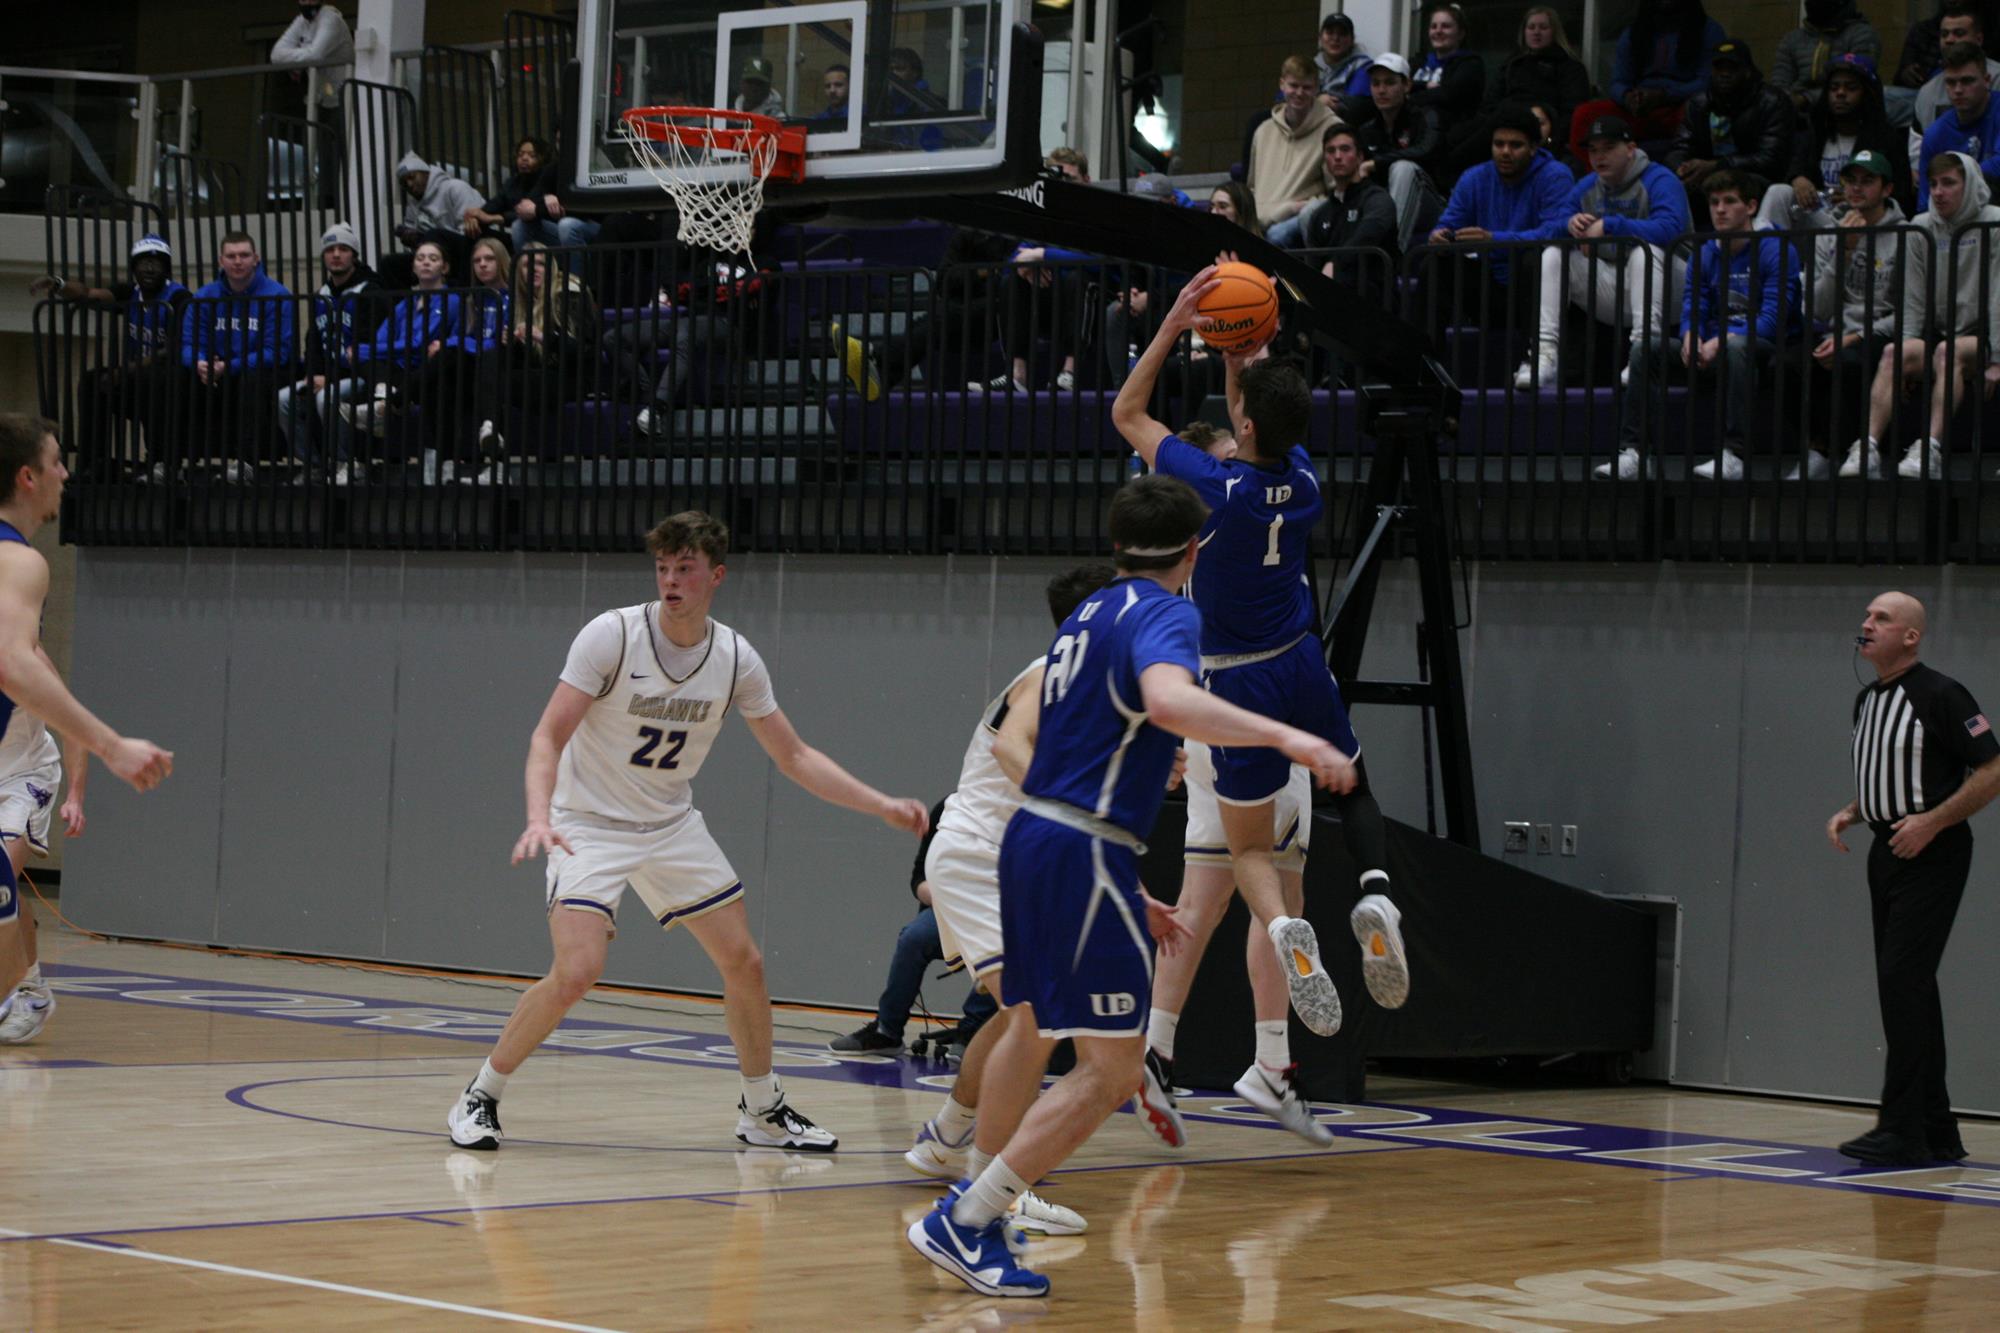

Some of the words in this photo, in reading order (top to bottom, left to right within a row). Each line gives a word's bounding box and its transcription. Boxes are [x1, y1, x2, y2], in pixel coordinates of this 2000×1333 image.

[588, 172, 628, 187] SPALDING
[1262, 513, 1284, 566] 1
[629, 725, 688, 770] 22
[1326, 1248, 2000, 1333] NCAA
